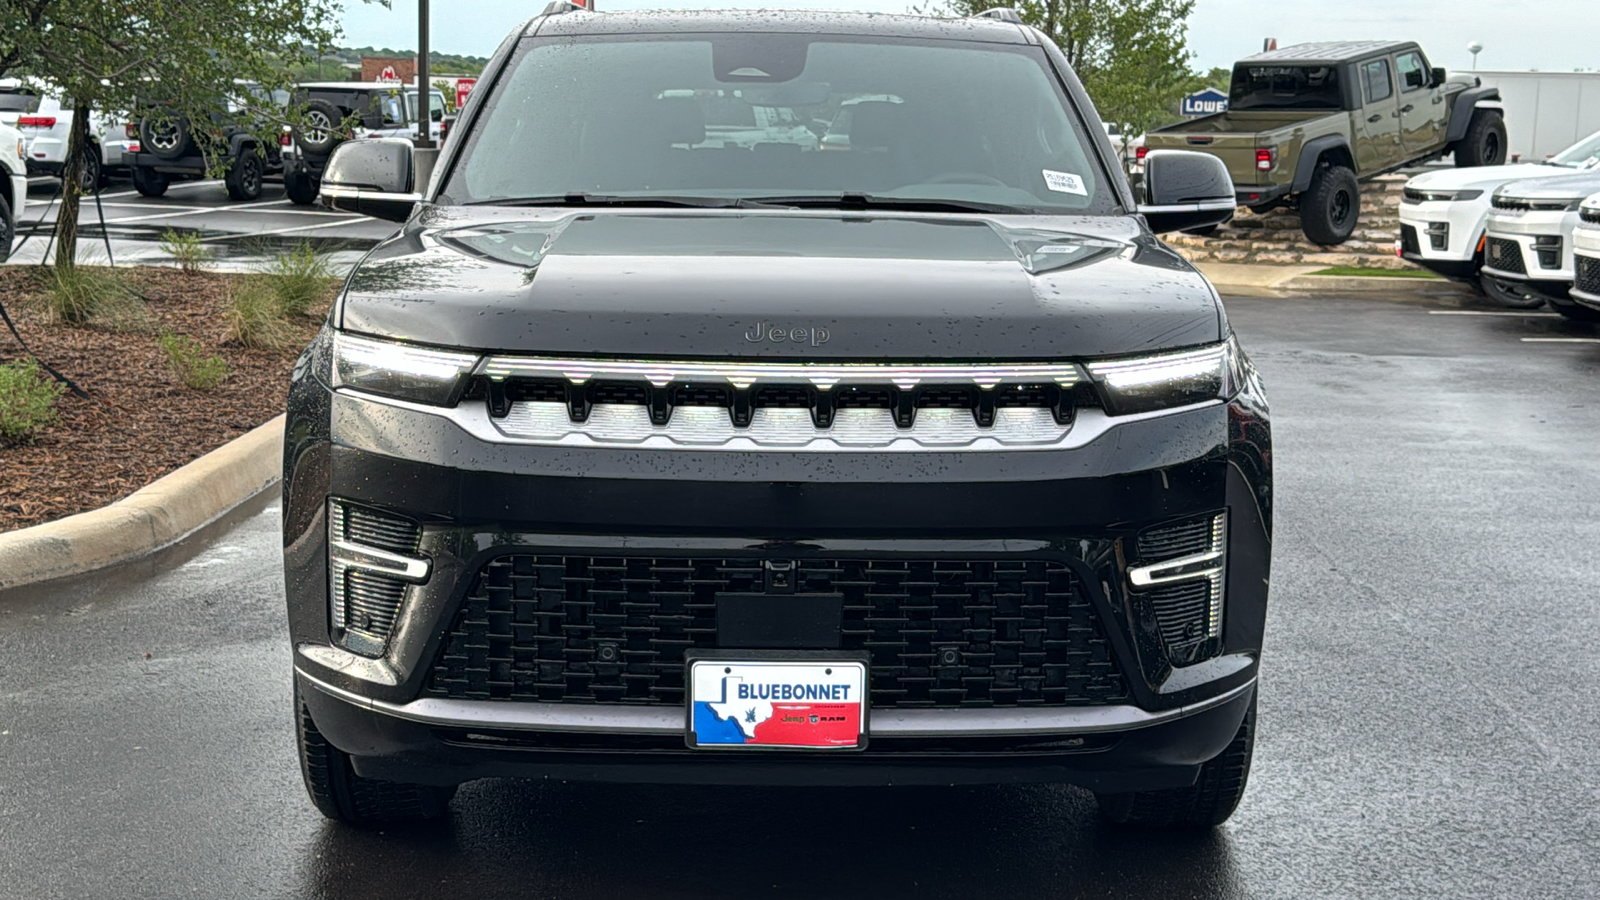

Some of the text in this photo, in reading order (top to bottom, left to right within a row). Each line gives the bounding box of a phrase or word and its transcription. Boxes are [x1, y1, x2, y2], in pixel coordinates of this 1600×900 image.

[745, 322, 830, 347] Jeep
[738, 683, 851, 700] BLUEBONNET
[780, 713, 805, 724] Jeep
